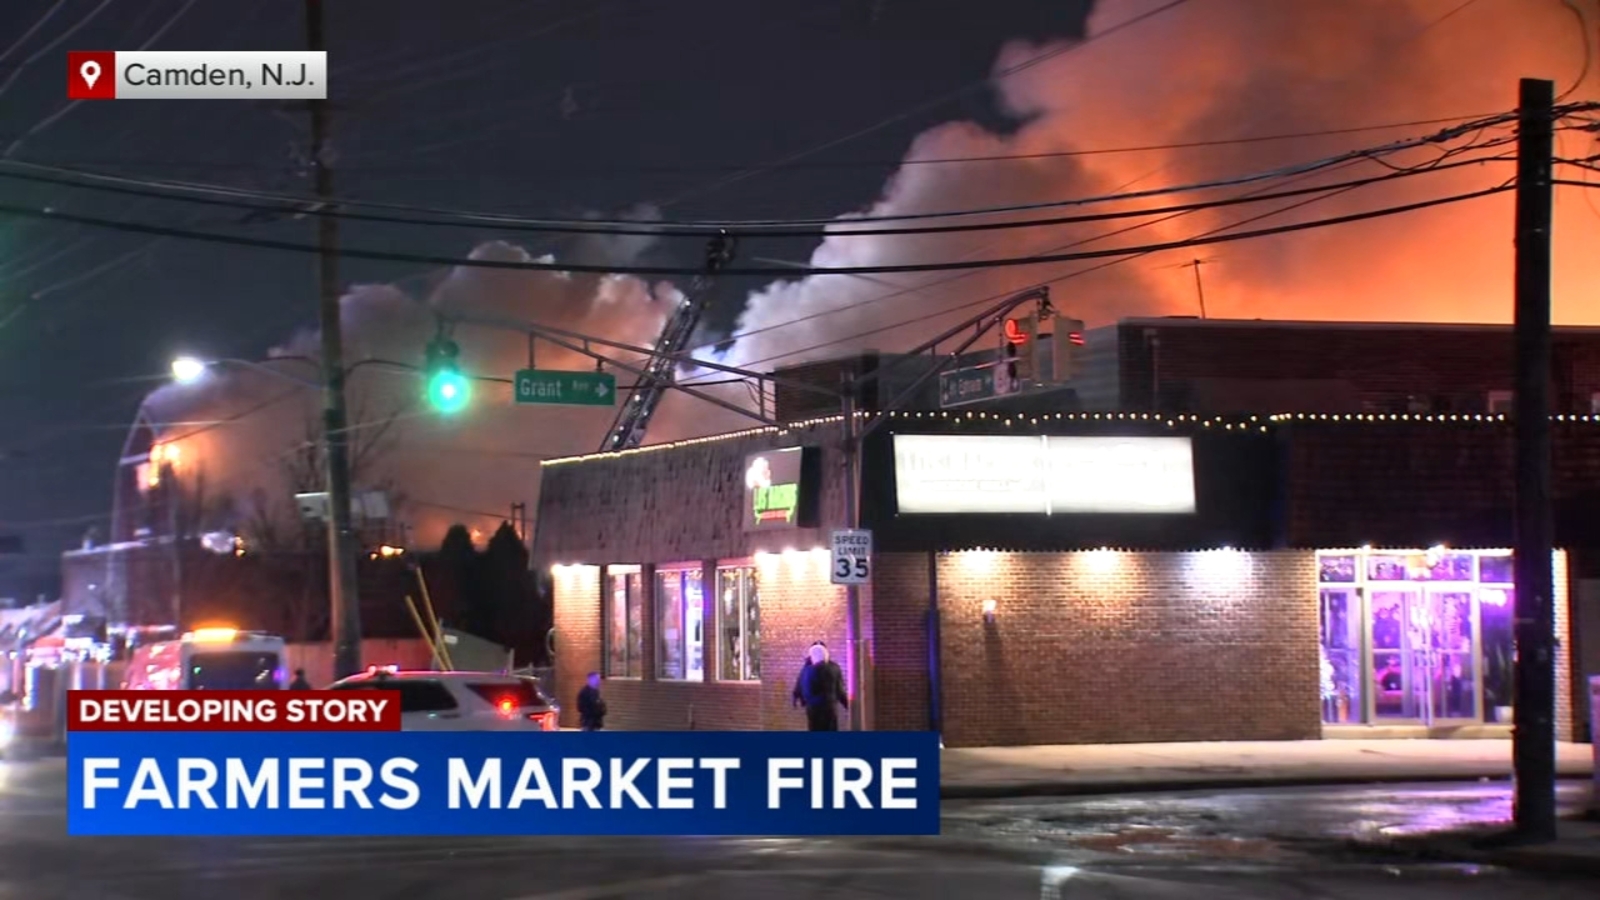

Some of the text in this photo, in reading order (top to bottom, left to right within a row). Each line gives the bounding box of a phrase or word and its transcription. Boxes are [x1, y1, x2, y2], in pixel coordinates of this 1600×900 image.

[520, 378, 561, 397] Grant
[834, 535, 868, 545] SPEED
[838, 546, 866, 556] LIMIT
[835, 558, 869, 578] 35
